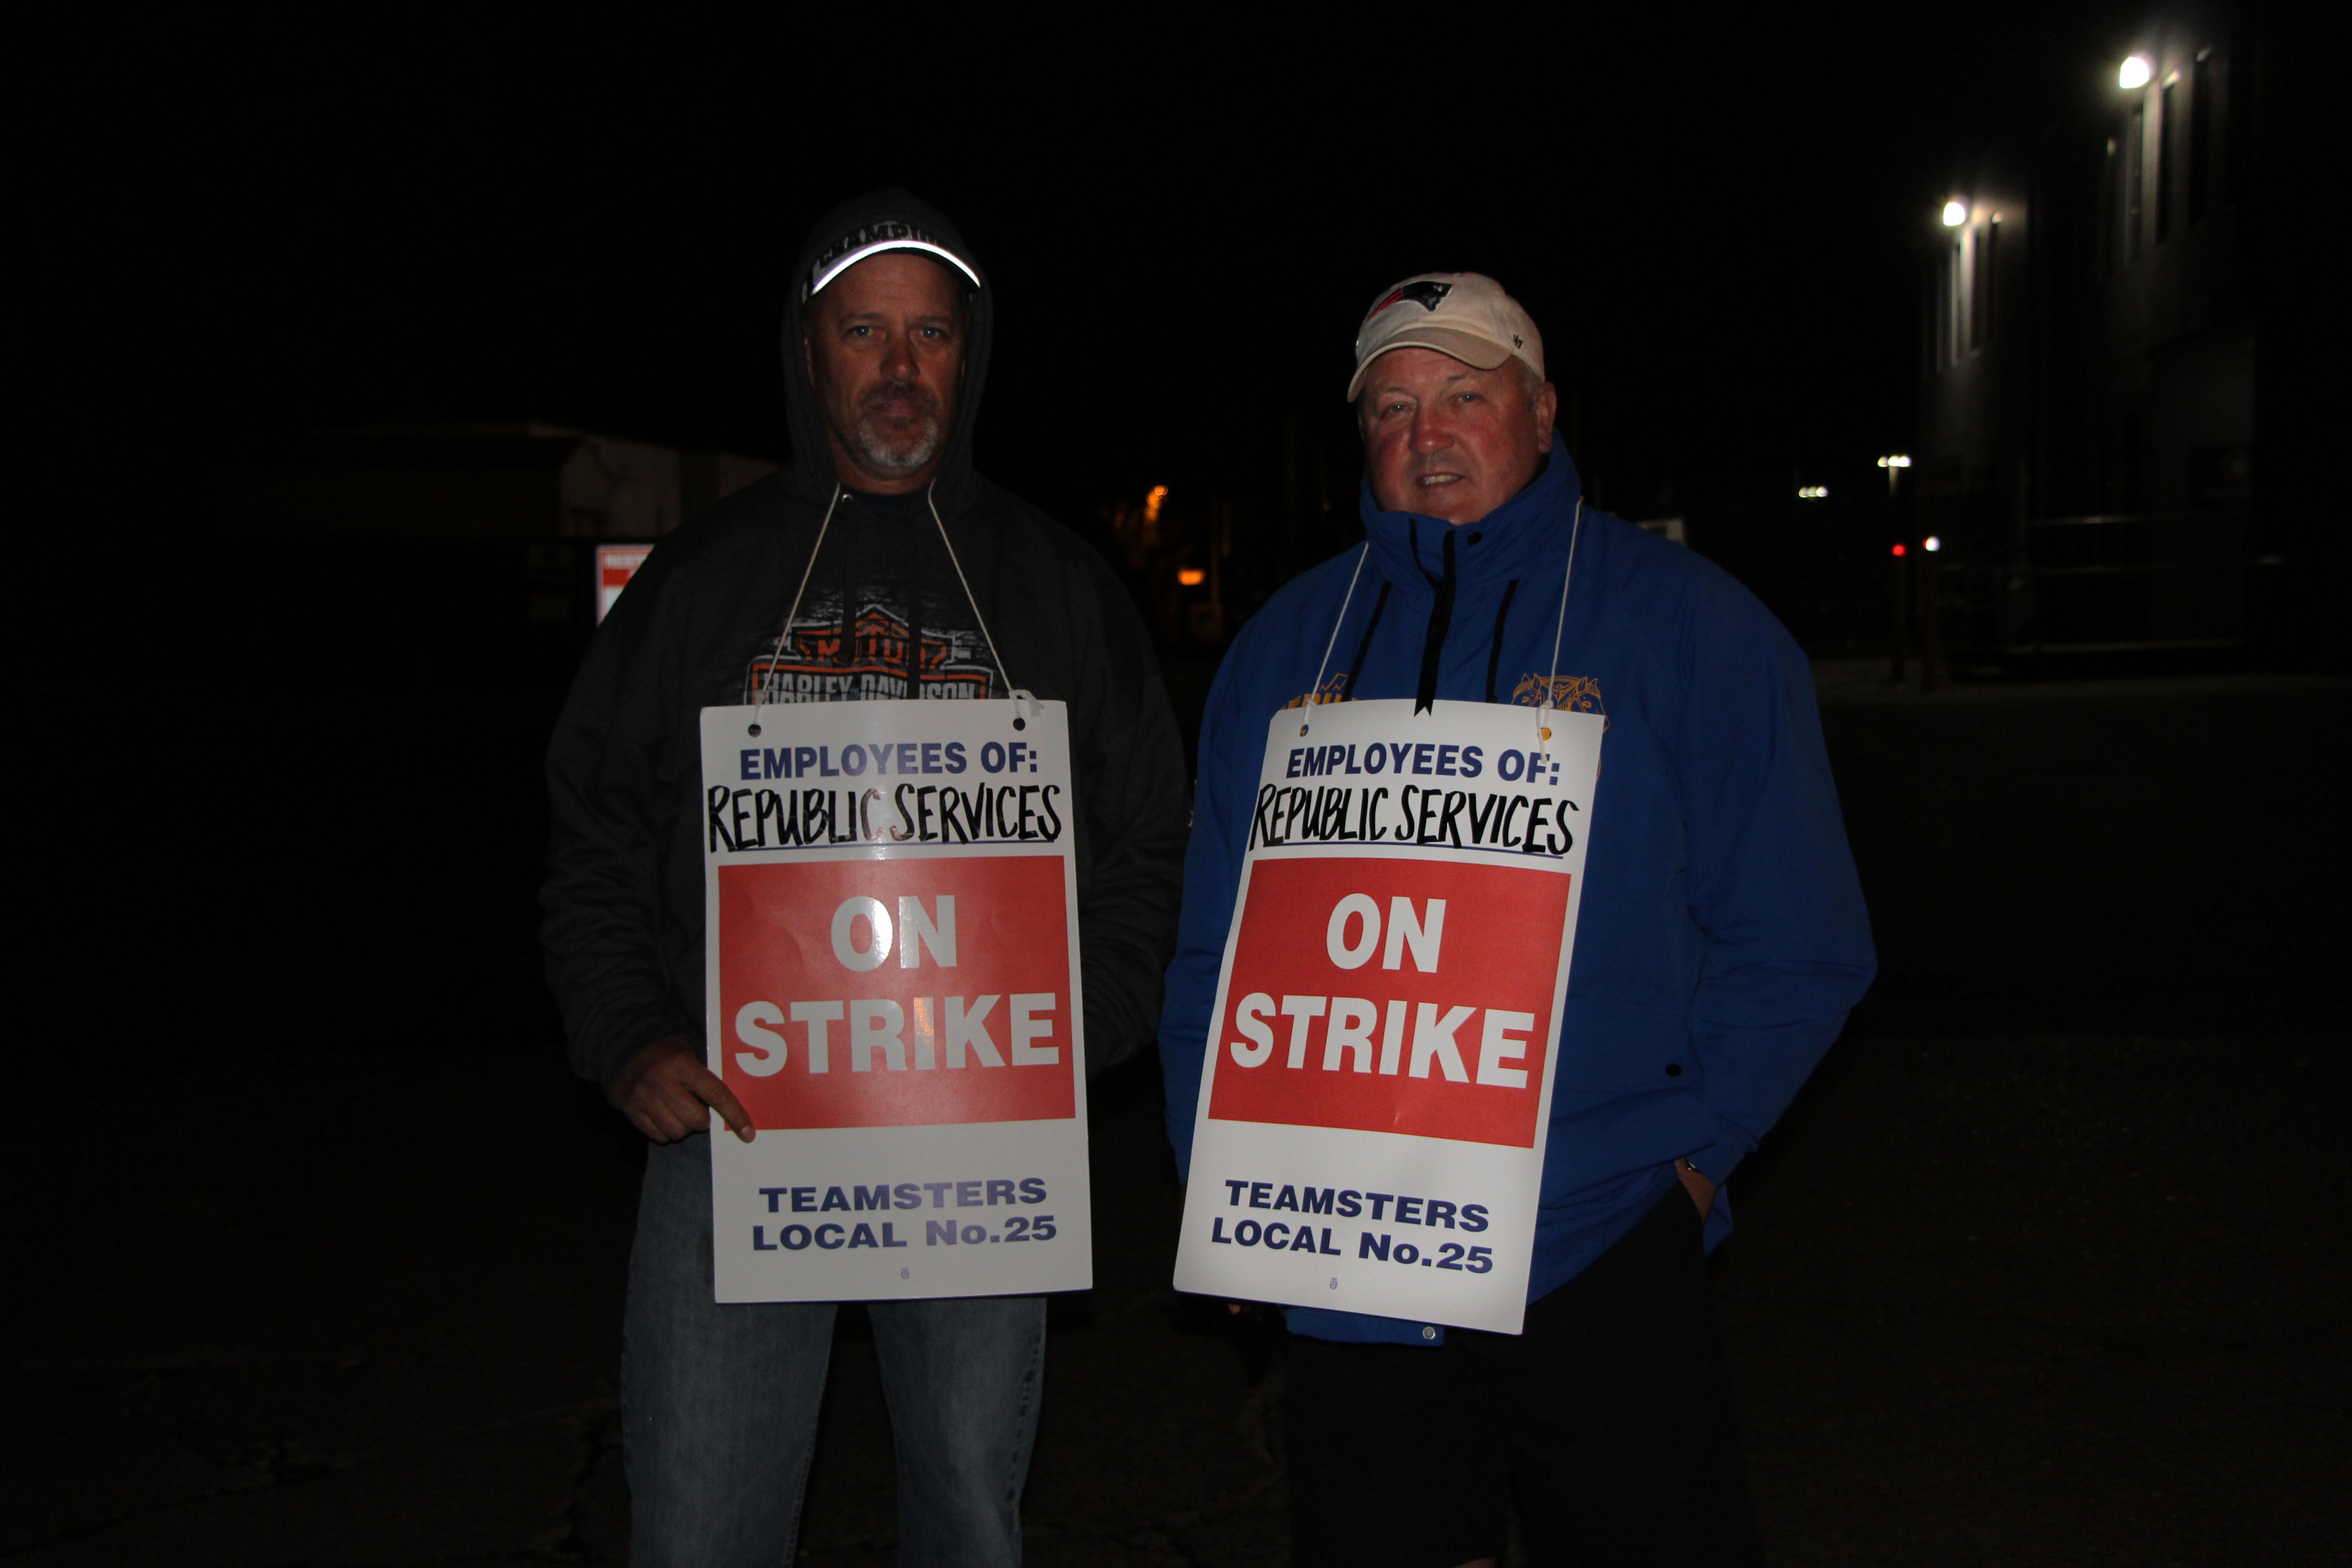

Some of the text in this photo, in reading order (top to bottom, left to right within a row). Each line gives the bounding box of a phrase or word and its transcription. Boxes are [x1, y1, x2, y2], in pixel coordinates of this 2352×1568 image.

[740, 741, 1038, 780] EMPLOYEES OF:
[1286, 742, 1560, 786] EMPLOYEES OF:
[708, 782, 1062, 853] REPUBLIC SERVICES
[1249, 783, 1580, 856] REPUBLIC SERVICES
[830, 894, 957, 971] ON
[1326, 892, 1447, 974] ON
[734, 992, 1060, 1077] STRIKE
[1230, 992, 1535, 1089] STRIKE
[759, 1177, 1047, 1213] TEAMSTERS
[1225, 1180, 1490, 1233] TEAMSTERS
[753, 1215, 1057, 1251] LOCAL No.25
[1211, 1217, 1494, 1274] LOCAL No.25
